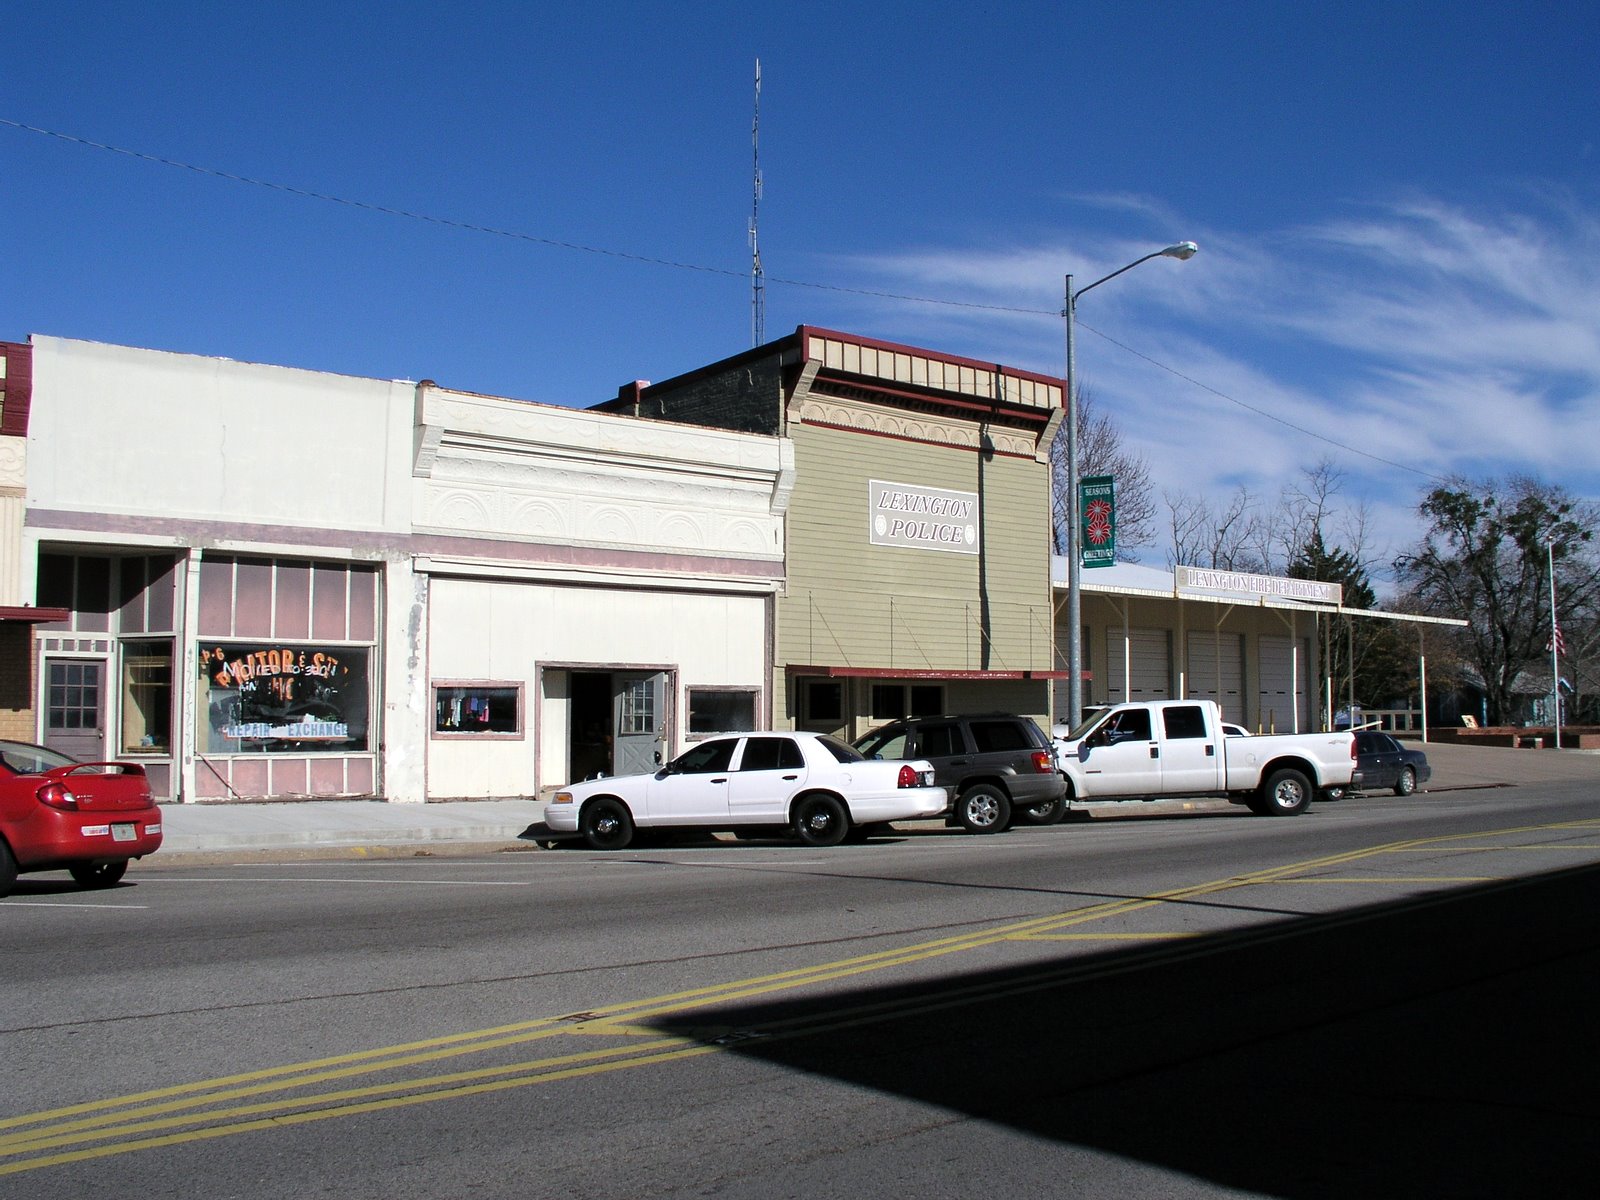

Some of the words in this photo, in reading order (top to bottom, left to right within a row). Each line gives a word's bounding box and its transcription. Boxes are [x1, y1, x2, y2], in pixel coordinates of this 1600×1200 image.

[1085, 486, 1111, 496] SEASONS
[878, 490, 972, 519] LEXINGTON
[890, 519, 963, 544] POLICE
[1188, 570, 1249, 592] LEXINGTON
[1249, 577, 1271, 593] FIRE
[1272, 579, 1330, 599] DEPARTMENT
[228, 723, 270, 737] REPAIR
[288, 722, 348, 737] EXCHANGE
